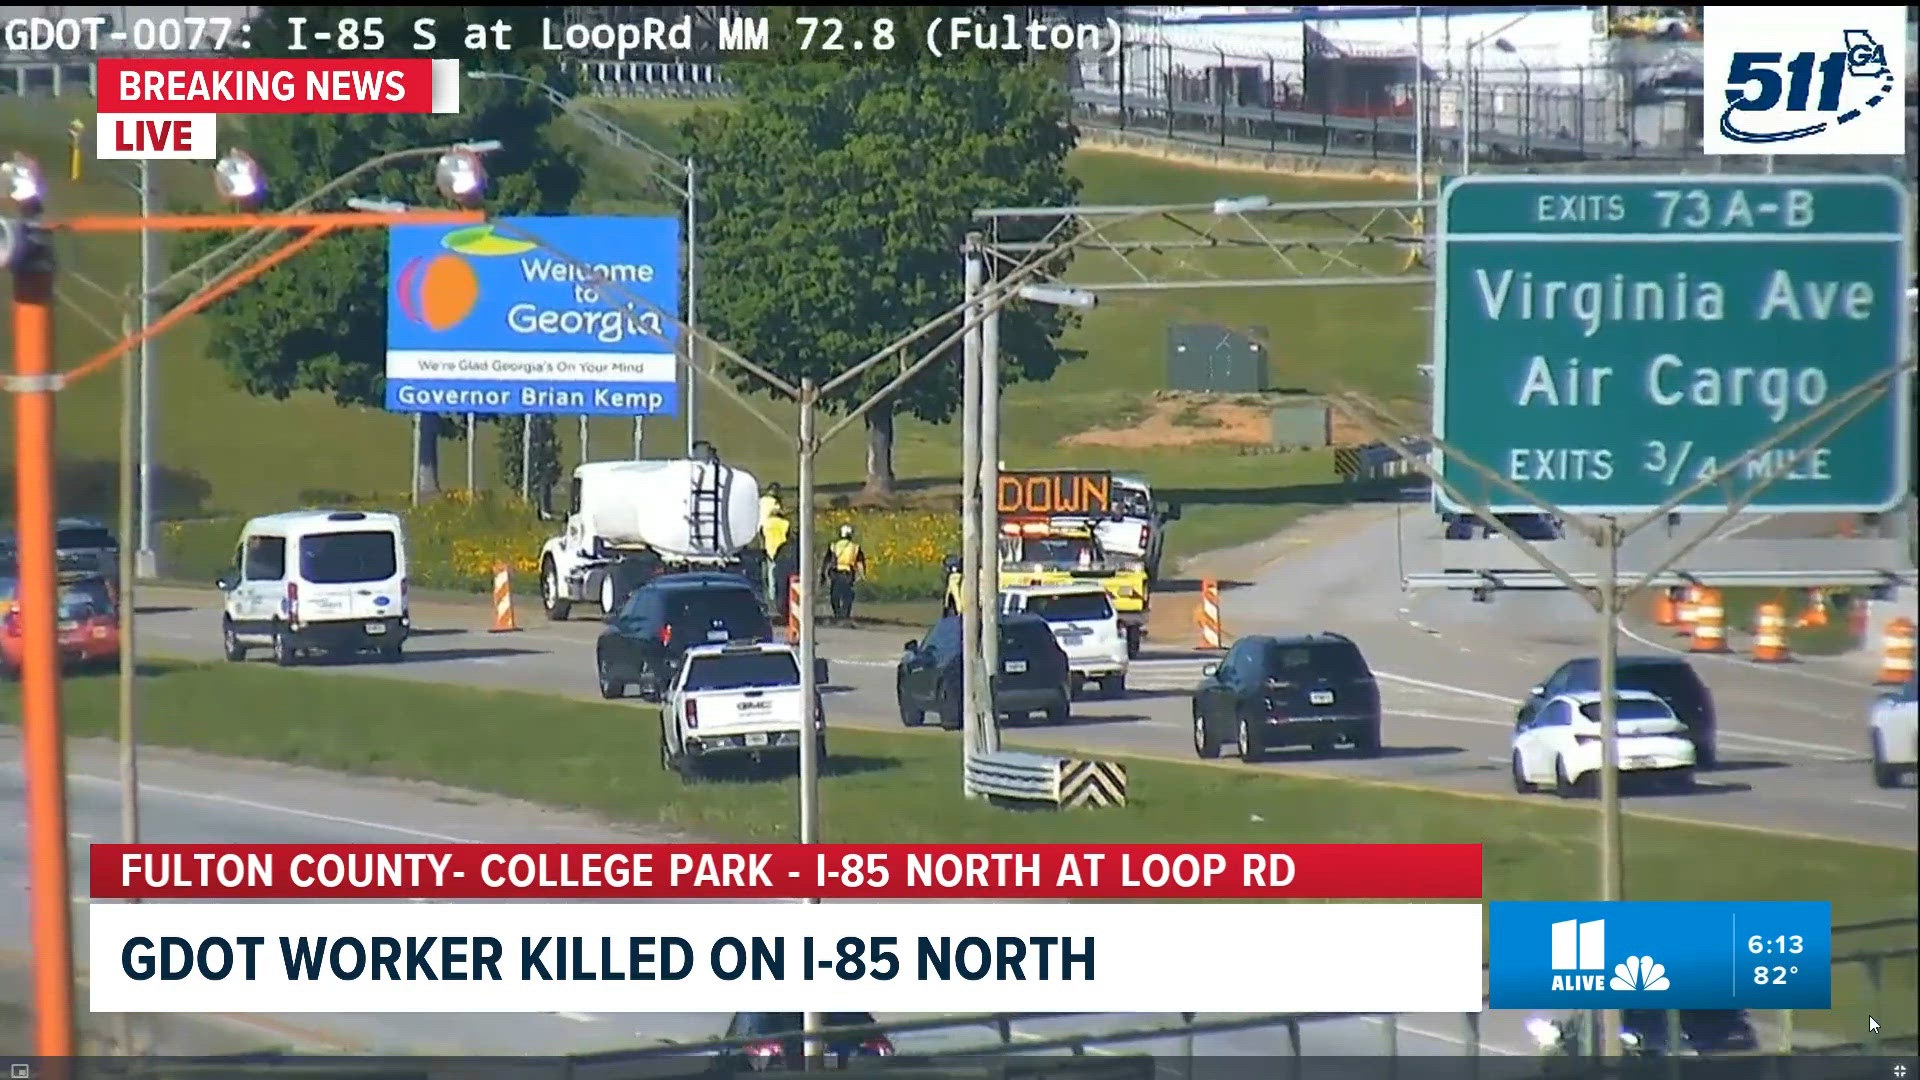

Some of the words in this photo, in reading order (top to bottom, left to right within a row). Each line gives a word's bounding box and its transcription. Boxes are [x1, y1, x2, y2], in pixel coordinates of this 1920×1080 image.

[1538, 195, 1625, 222] EXITS
[574, 284, 599, 303] to
[1476, 269, 1725, 337] Virginia
[1760, 269, 1875, 320] Ave
[507, 303, 662, 343] Georgia
[458, 360, 488, 372] Glad
[492, 360, 553, 374] Georgia's
[557, 361, 576, 372] On
[581, 362, 608, 373] Your
[612, 363, 644, 374] Mind
[398, 385, 510, 405] Governor
[521, 386, 584, 407] Brian
[595, 388, 663, 411] Kemp
[1519, 356, 1613, 406] Air
[1648, 354, 1828, 422] Cargo
[1510, 449, 1614, 481] EXITS
[998, 475, 1109, 512] DOWN
